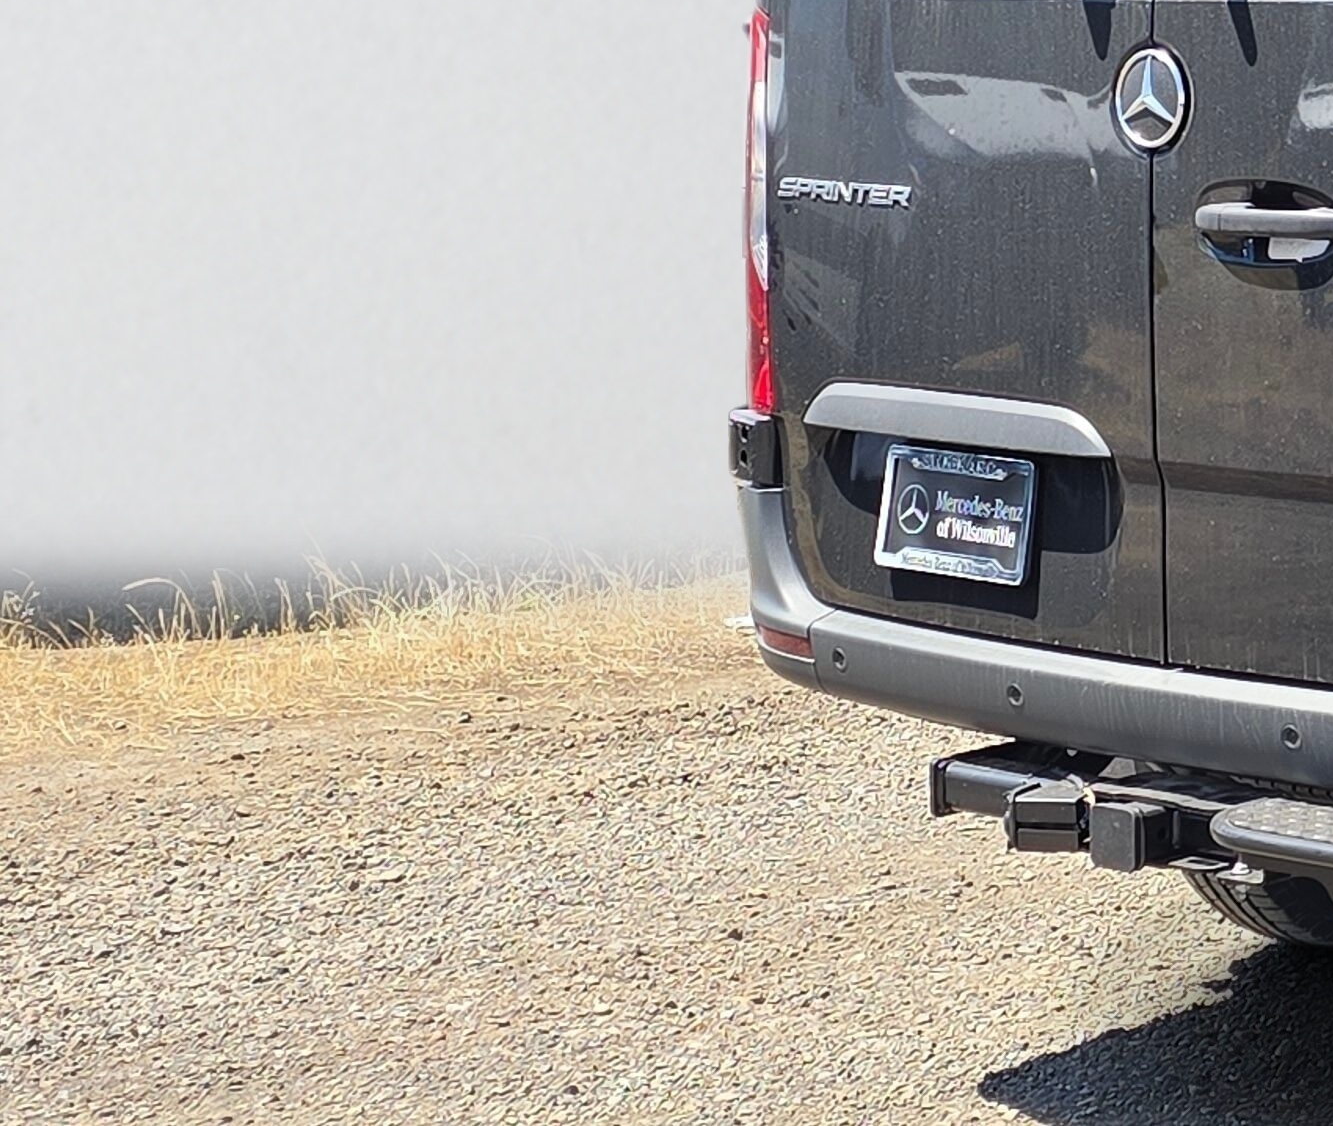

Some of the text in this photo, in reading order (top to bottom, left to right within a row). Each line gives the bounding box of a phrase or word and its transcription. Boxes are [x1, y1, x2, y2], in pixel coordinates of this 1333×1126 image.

[777, 176, 912, 207] SPRINTER
[934, 490, 1024, 522] Mercedes-Benz
[936, 517, 1017, 548] of Wilsonville
